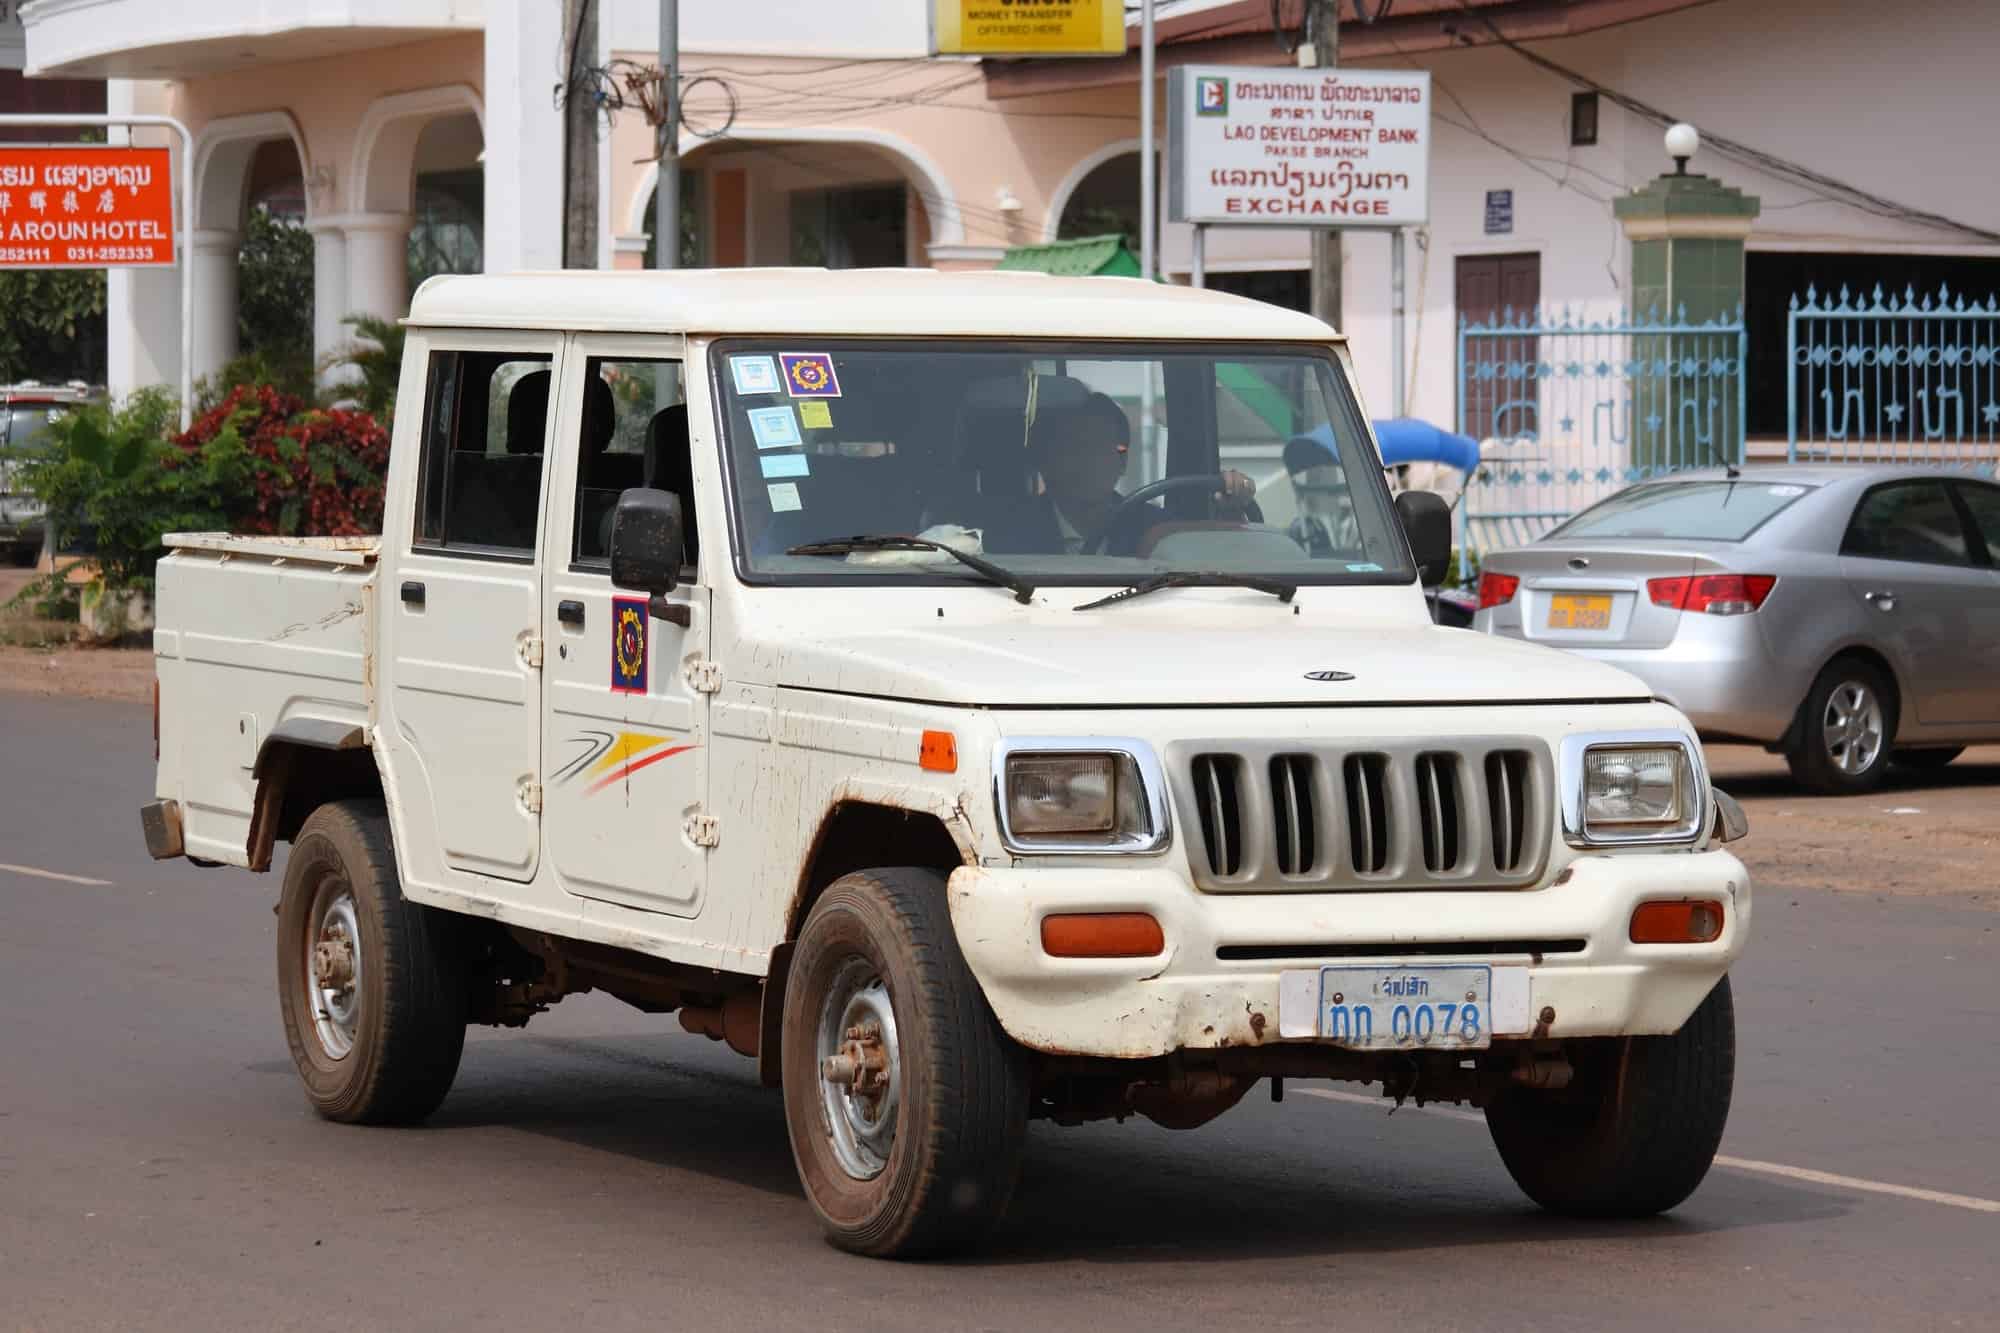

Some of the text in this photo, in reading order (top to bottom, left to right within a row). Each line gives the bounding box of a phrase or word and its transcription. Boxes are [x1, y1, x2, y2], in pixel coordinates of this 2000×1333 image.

[967, 9, 1073, 20] MONEY TRANSFER
[977, 24, 1064, 35] OFFERED HERE
[1223, 125, 1419, 144] LAO DEVELOPMENT BANK
[1264, 145, 1369, 159] PAKSE BRANCH
[1225, 197, 1390, 215] EXCHANGE
[9, 220, 88, 241] AROUN
[91, 220, 168, 240] HOTEL
[66, 246, 154, 261] 031-252333
[1392, 1002, 1481, 1044] 0078
